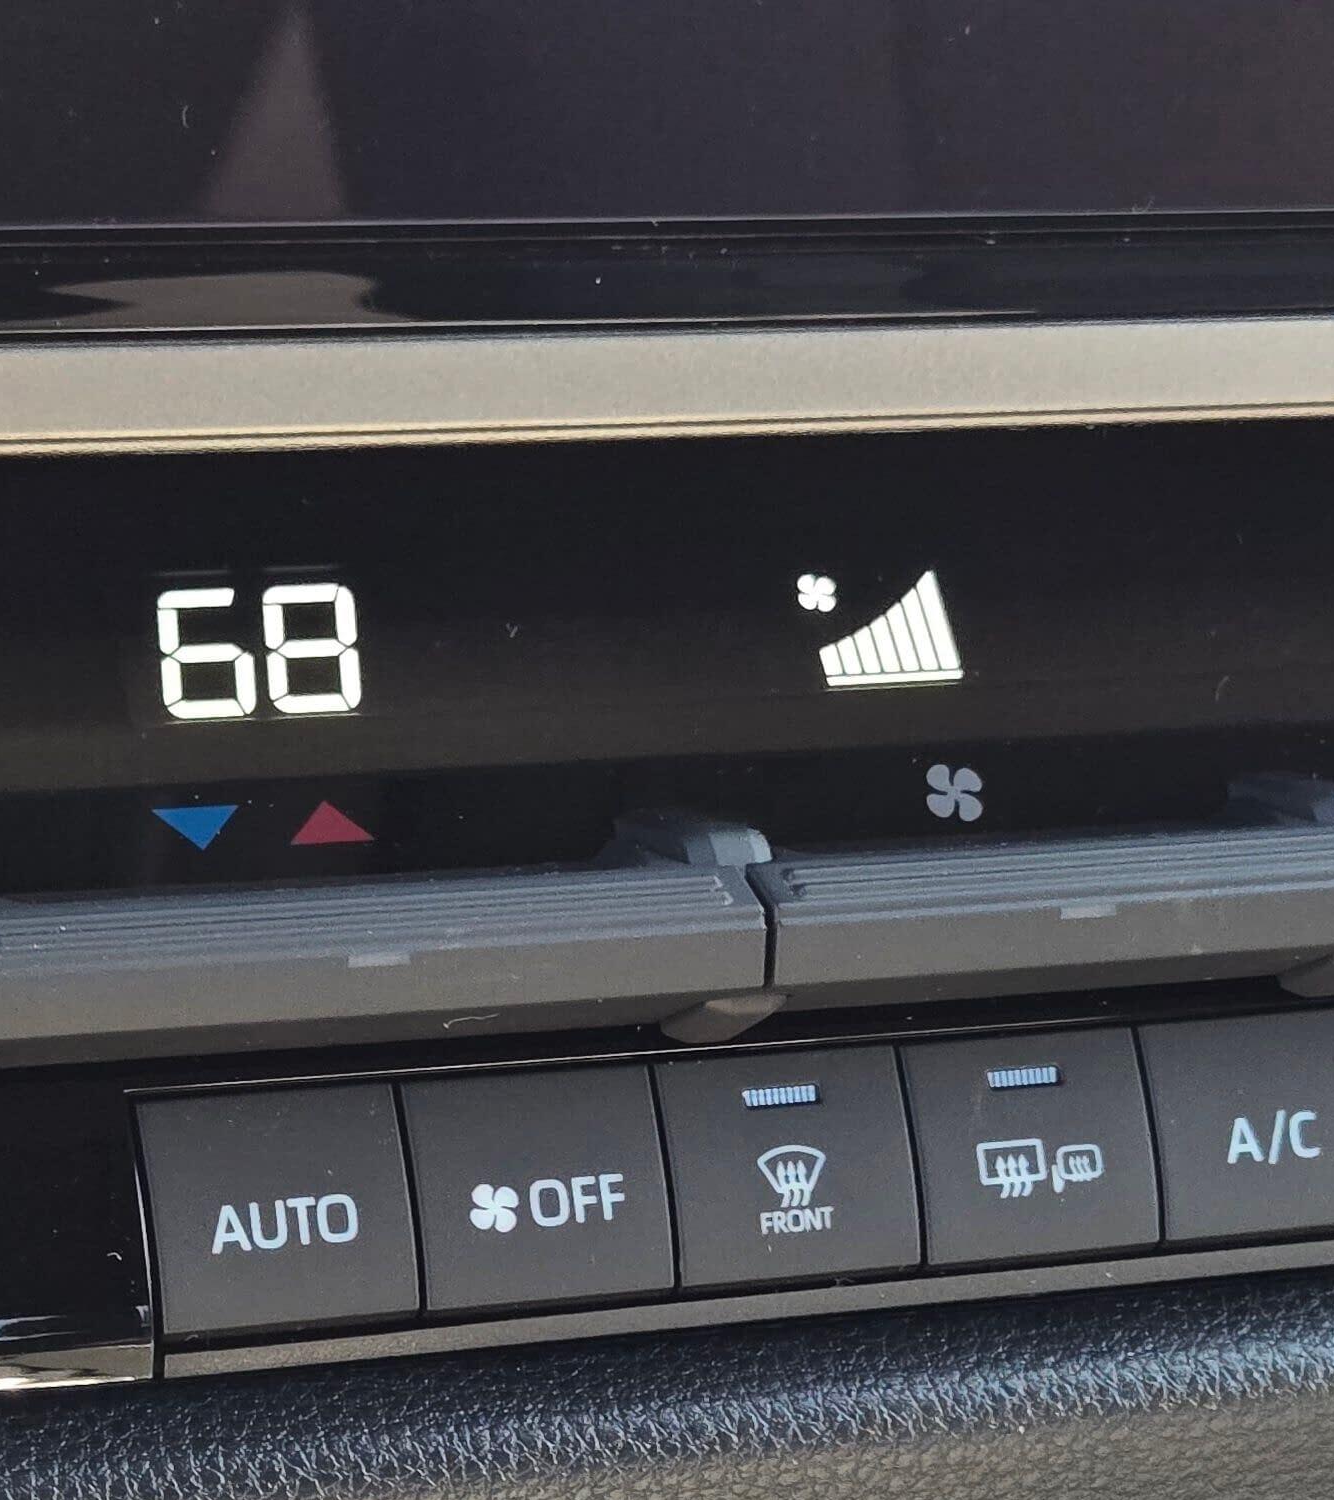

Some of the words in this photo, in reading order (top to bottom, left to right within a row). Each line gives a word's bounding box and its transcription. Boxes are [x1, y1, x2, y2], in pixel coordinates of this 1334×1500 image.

[156, 582, 363, 719] 68
[1227, 1109, 1322, 1166] A/C
[211, 1193, 359, 1255] AUTO
[529, 1173, 625, 1228] OFF
[760, 1205, 834, 1236] FRONT
